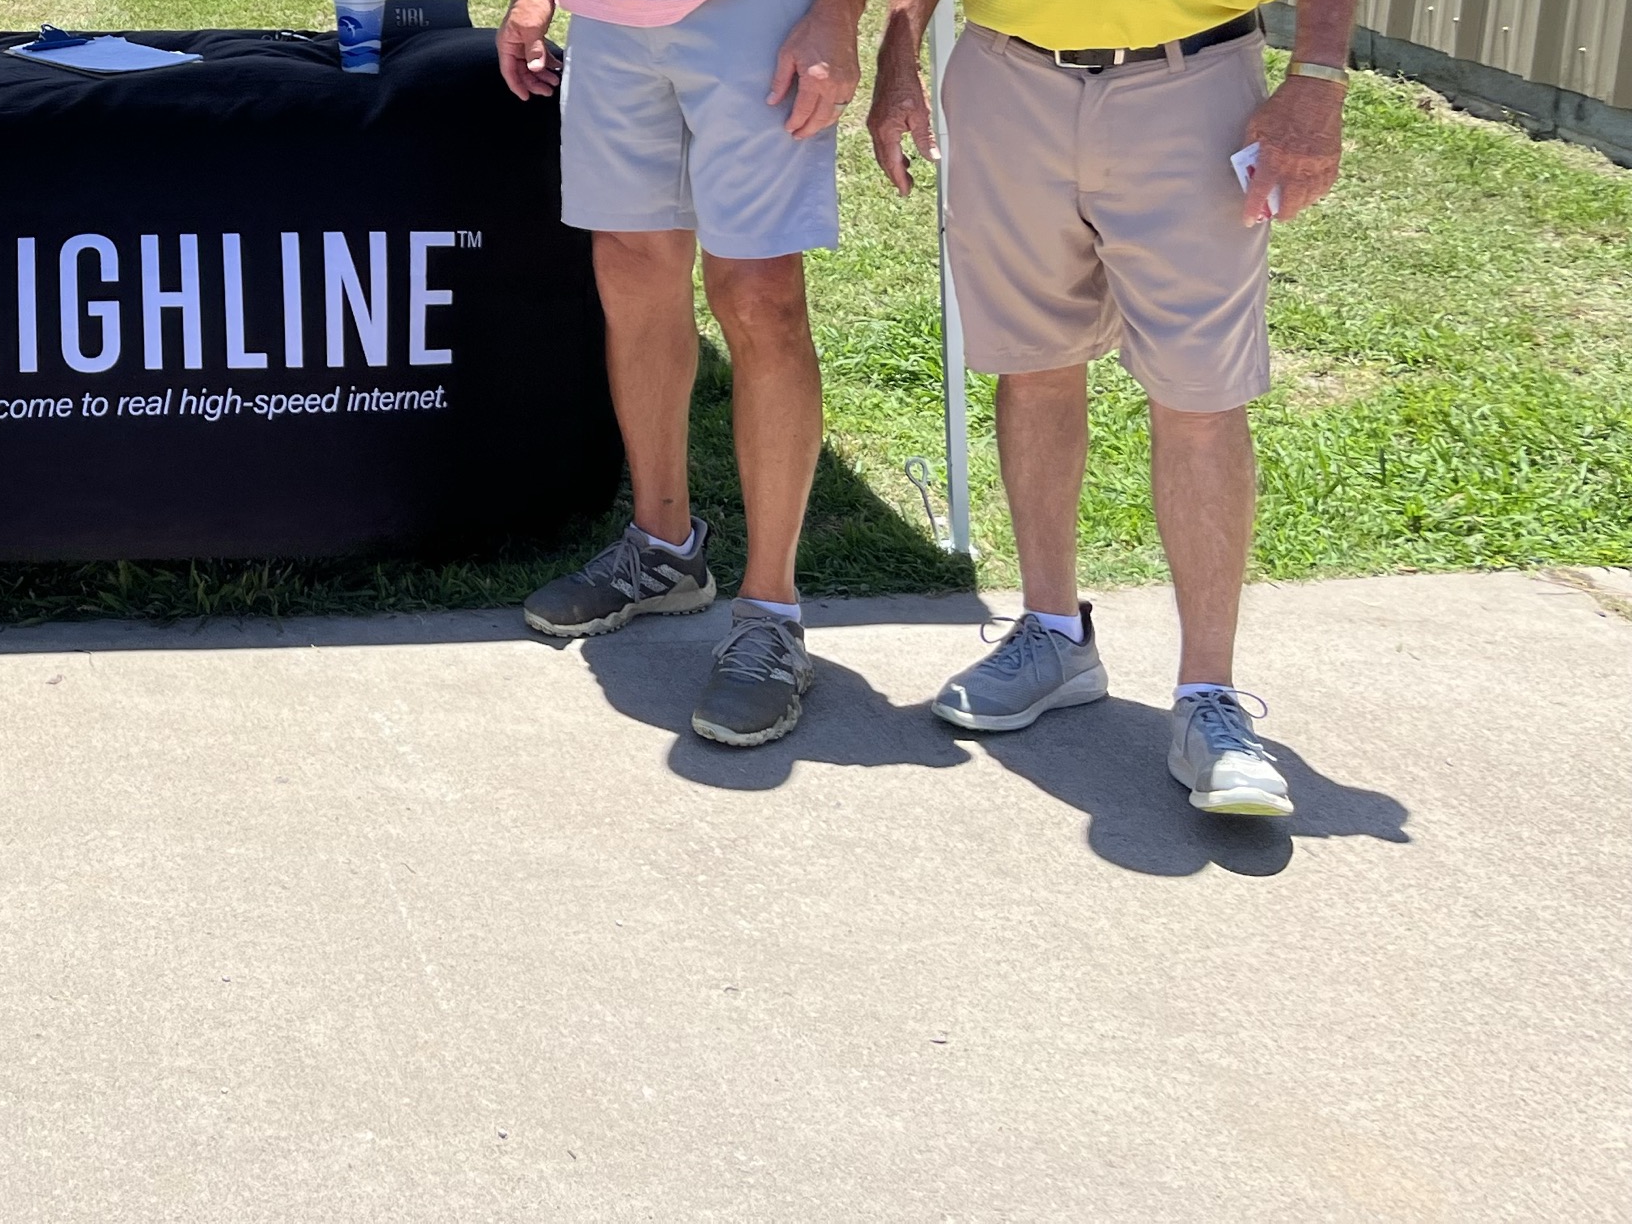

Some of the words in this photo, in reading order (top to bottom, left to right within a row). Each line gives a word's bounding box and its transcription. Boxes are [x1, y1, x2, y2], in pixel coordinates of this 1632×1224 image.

[396, 7, 430, 27] JBL
[81, 392, 109, 417] to
[116, 388, 173, 417] real
[179, 385, 341, 422] high-speed
[346, 384, 448, 413] internet.
